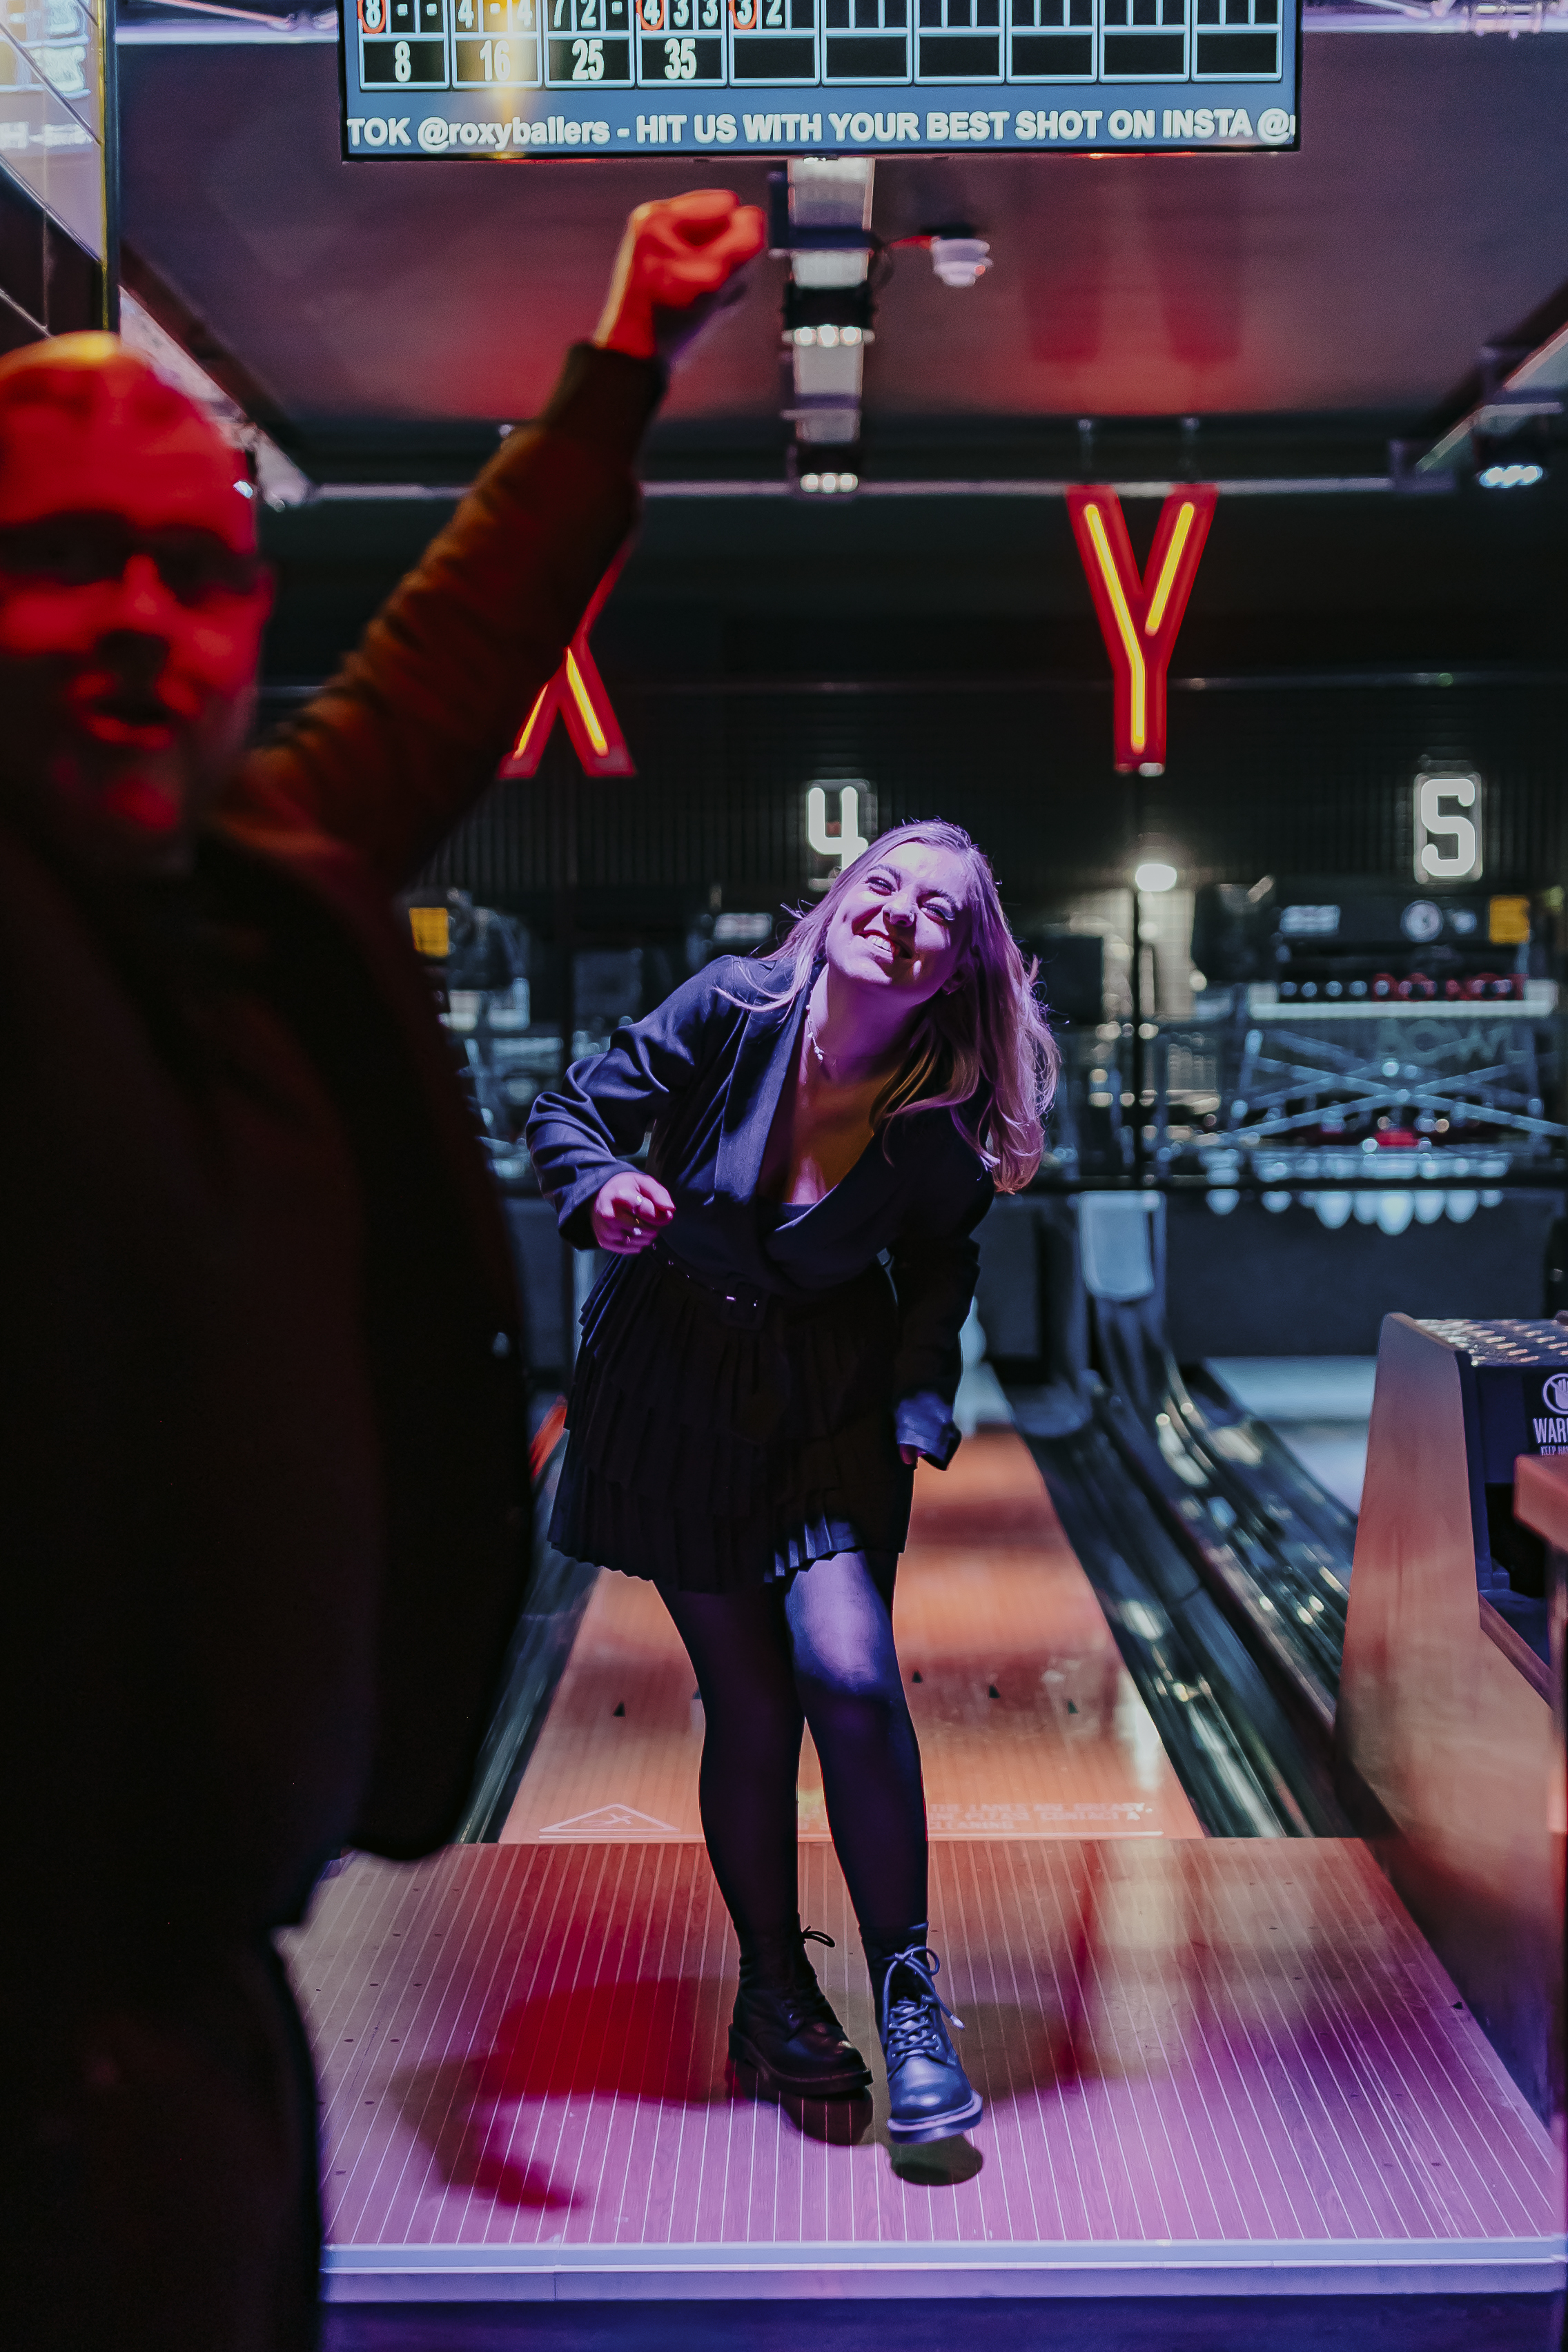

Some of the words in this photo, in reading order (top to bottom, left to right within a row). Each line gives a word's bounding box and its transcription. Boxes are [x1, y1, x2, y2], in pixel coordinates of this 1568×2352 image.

[394, 41, 411, 82] 8
[480, 39, 511, 81] 16
[572, 39, 605, 80] 25
[665, 38, 697, 79] 35
[418, 115, 610, 153] @roxyballers
[636, 115, 687, 144] HIT
[694, 113, 738, 144] US
[742, 112, 823, 143] WITH
[828, 112, 921, 142] YOUR
[926, 110, 1010, 141] BEST
[1015, 110, 1103, 141] SHOT
[1108, 109, 1155, 140] ON
[1162, 108, 1253, 139] INSTA
[1064, 484, 1219, 773] Y
[807, 786, 869, 872] 4
[1420, 778, 1476, 876] 5
[1533, 1418, 1568, 1444] WAR
